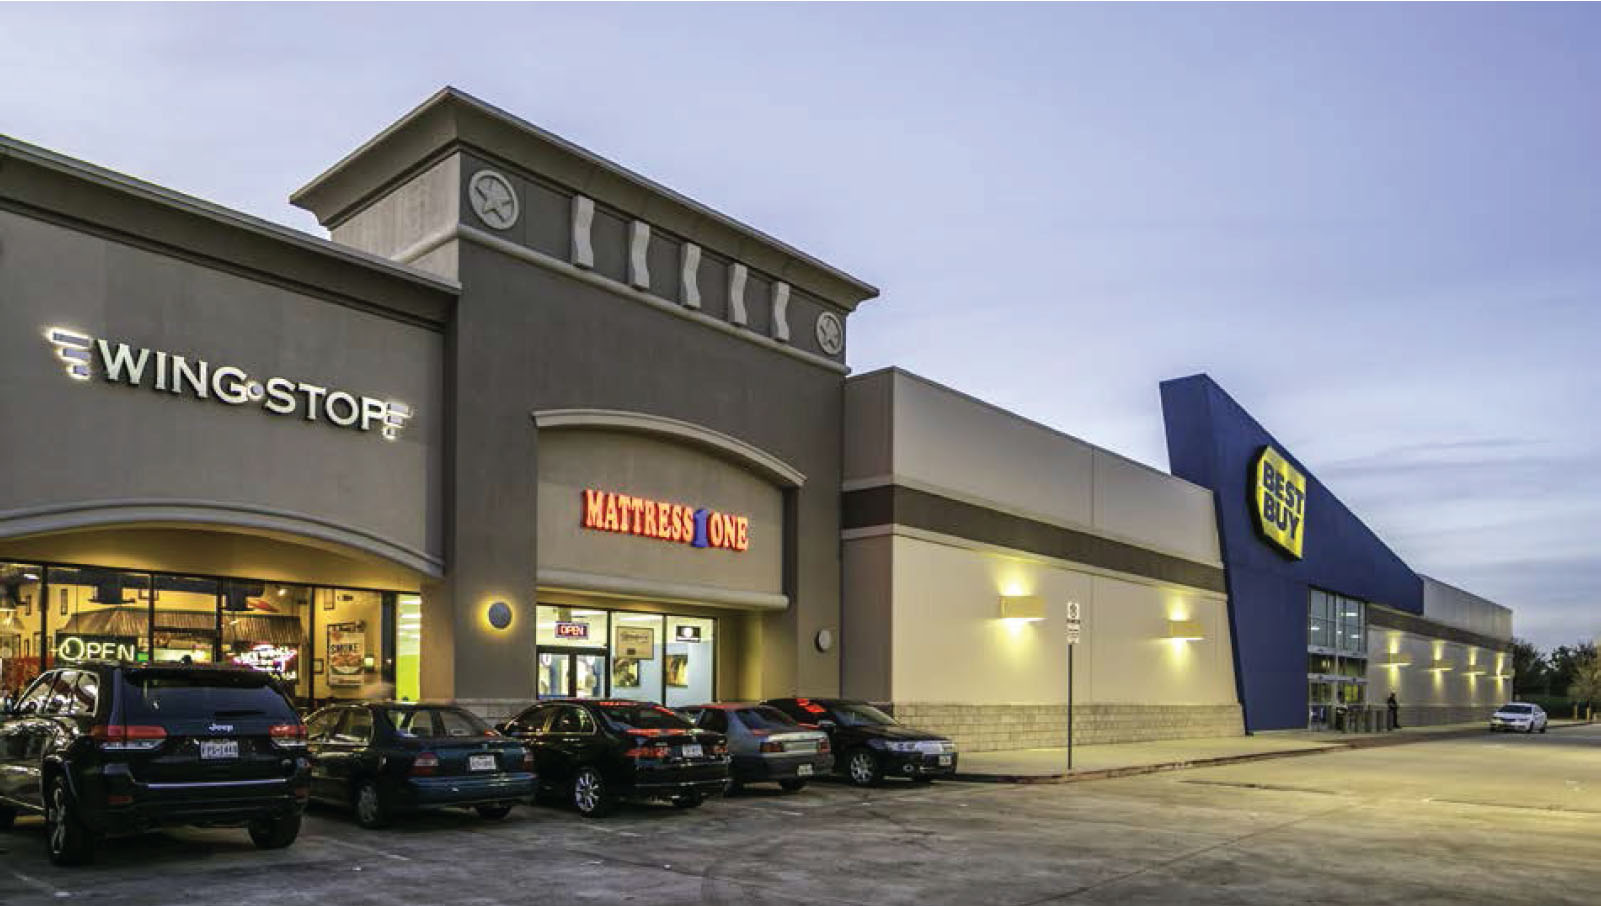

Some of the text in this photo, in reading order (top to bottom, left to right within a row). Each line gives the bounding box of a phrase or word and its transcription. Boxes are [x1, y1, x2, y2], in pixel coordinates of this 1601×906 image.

[1263, 460, 1304, 515] BEST
[582, 489, 694, 544] MATTRESS
[709, 511, 749, 550] ONE
[1263, 490, 1301, 540] BUY
[59, 636, 135, 663] OPEN
[560, 625, 584, 636] OPEN
[208, 723, 234, 733] Jeep
